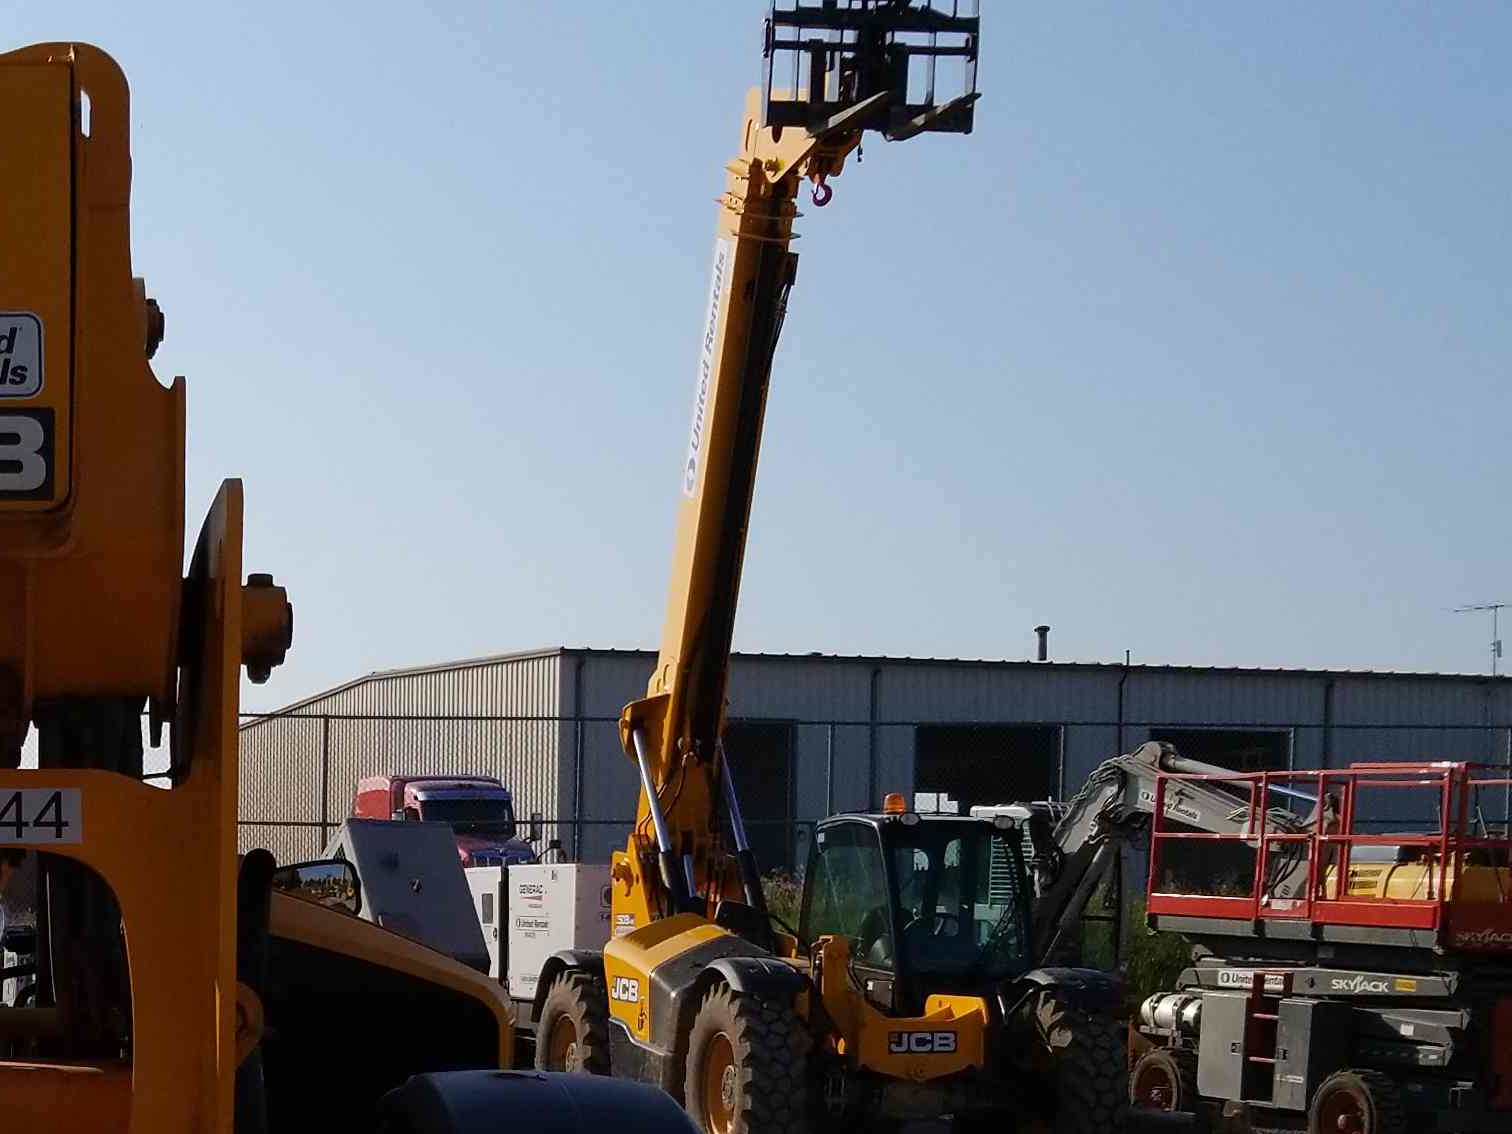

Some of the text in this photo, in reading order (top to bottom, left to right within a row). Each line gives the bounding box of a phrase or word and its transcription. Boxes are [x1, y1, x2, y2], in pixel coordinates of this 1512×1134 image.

[690, 251, 726, 453] United Rentals
[611, 977, 639, 1002] JCB
[1330, 975, 1389, 994] SKYJACK
[889, 1032, 957, 1053] JCB
